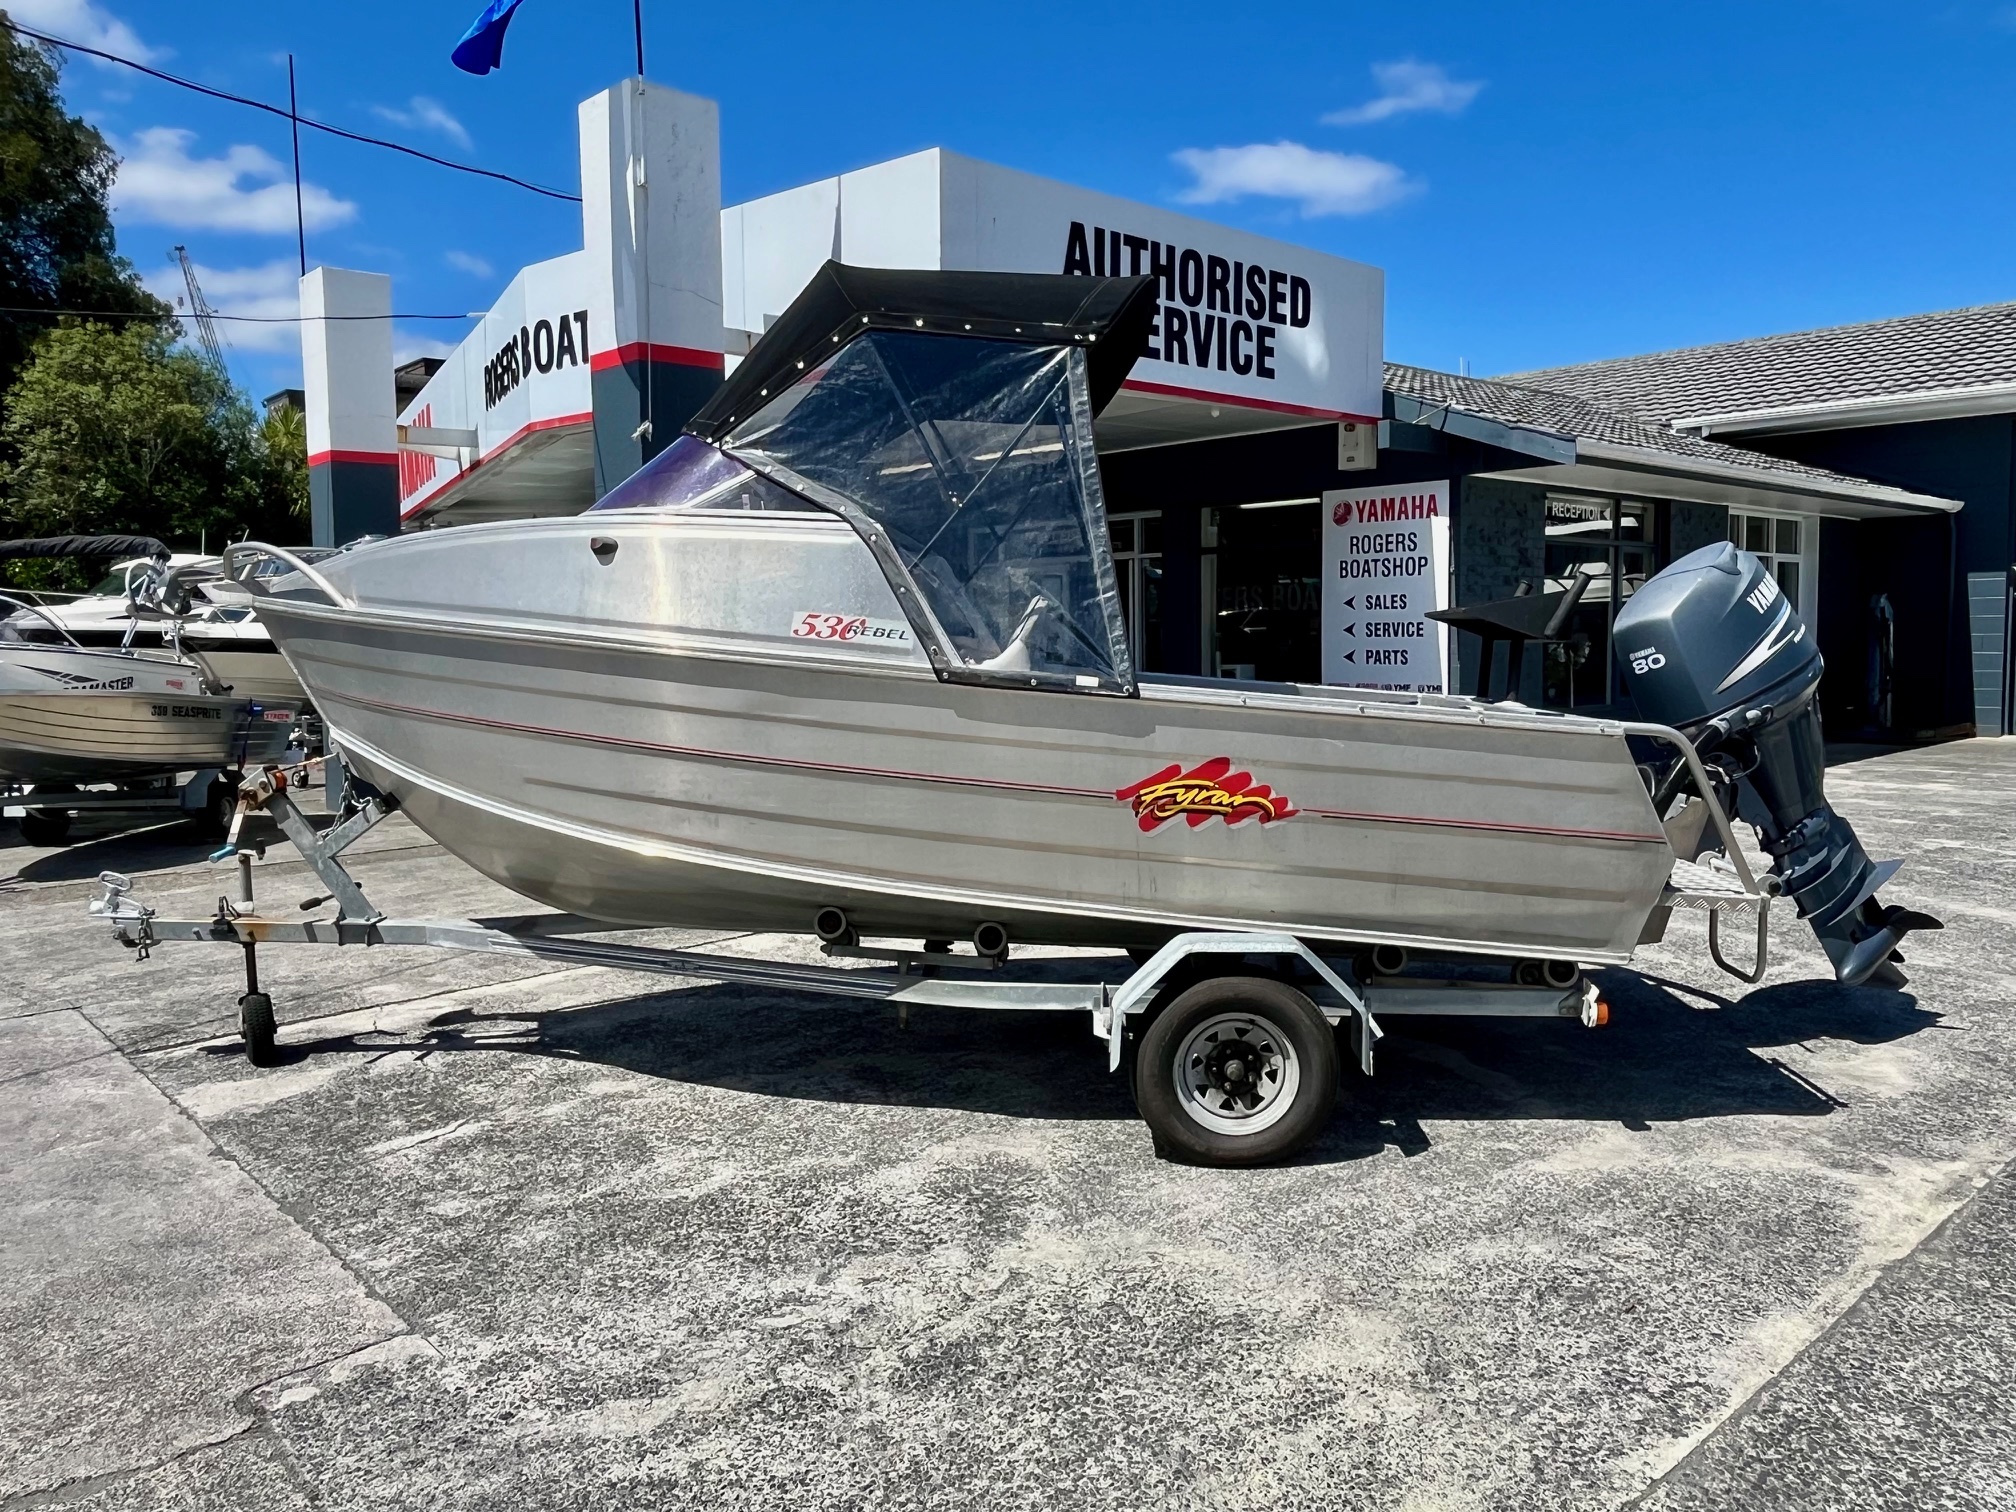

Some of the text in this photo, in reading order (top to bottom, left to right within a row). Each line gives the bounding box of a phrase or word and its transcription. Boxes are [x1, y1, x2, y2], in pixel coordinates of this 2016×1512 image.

[1063, 221, 1311, 329] AUTHORISED
[1147, 302, 1276, 380] ERVICE
[484, 333, 520, 412] ROGERS
[1355, 493, 1439, 523] YAMAHA
[1552, 501, 1601, 521] RECEPTION
[1349, 532, 1418, 555] ROGERS
[1339, 556, 1429, 579] BOATSHOP
[1365, 593, 1407, 611] SALES
[847, 624, 910, 641] REBEL
[1365, 621, 1424, 638] SERVICE
[1365, 649, 1408, 666] PARTS
[1632, 653, 1666, 675] 80
[172, 705, 222, 719] SEASPRITE
[1139, 779, 1275, 818] Fyran
